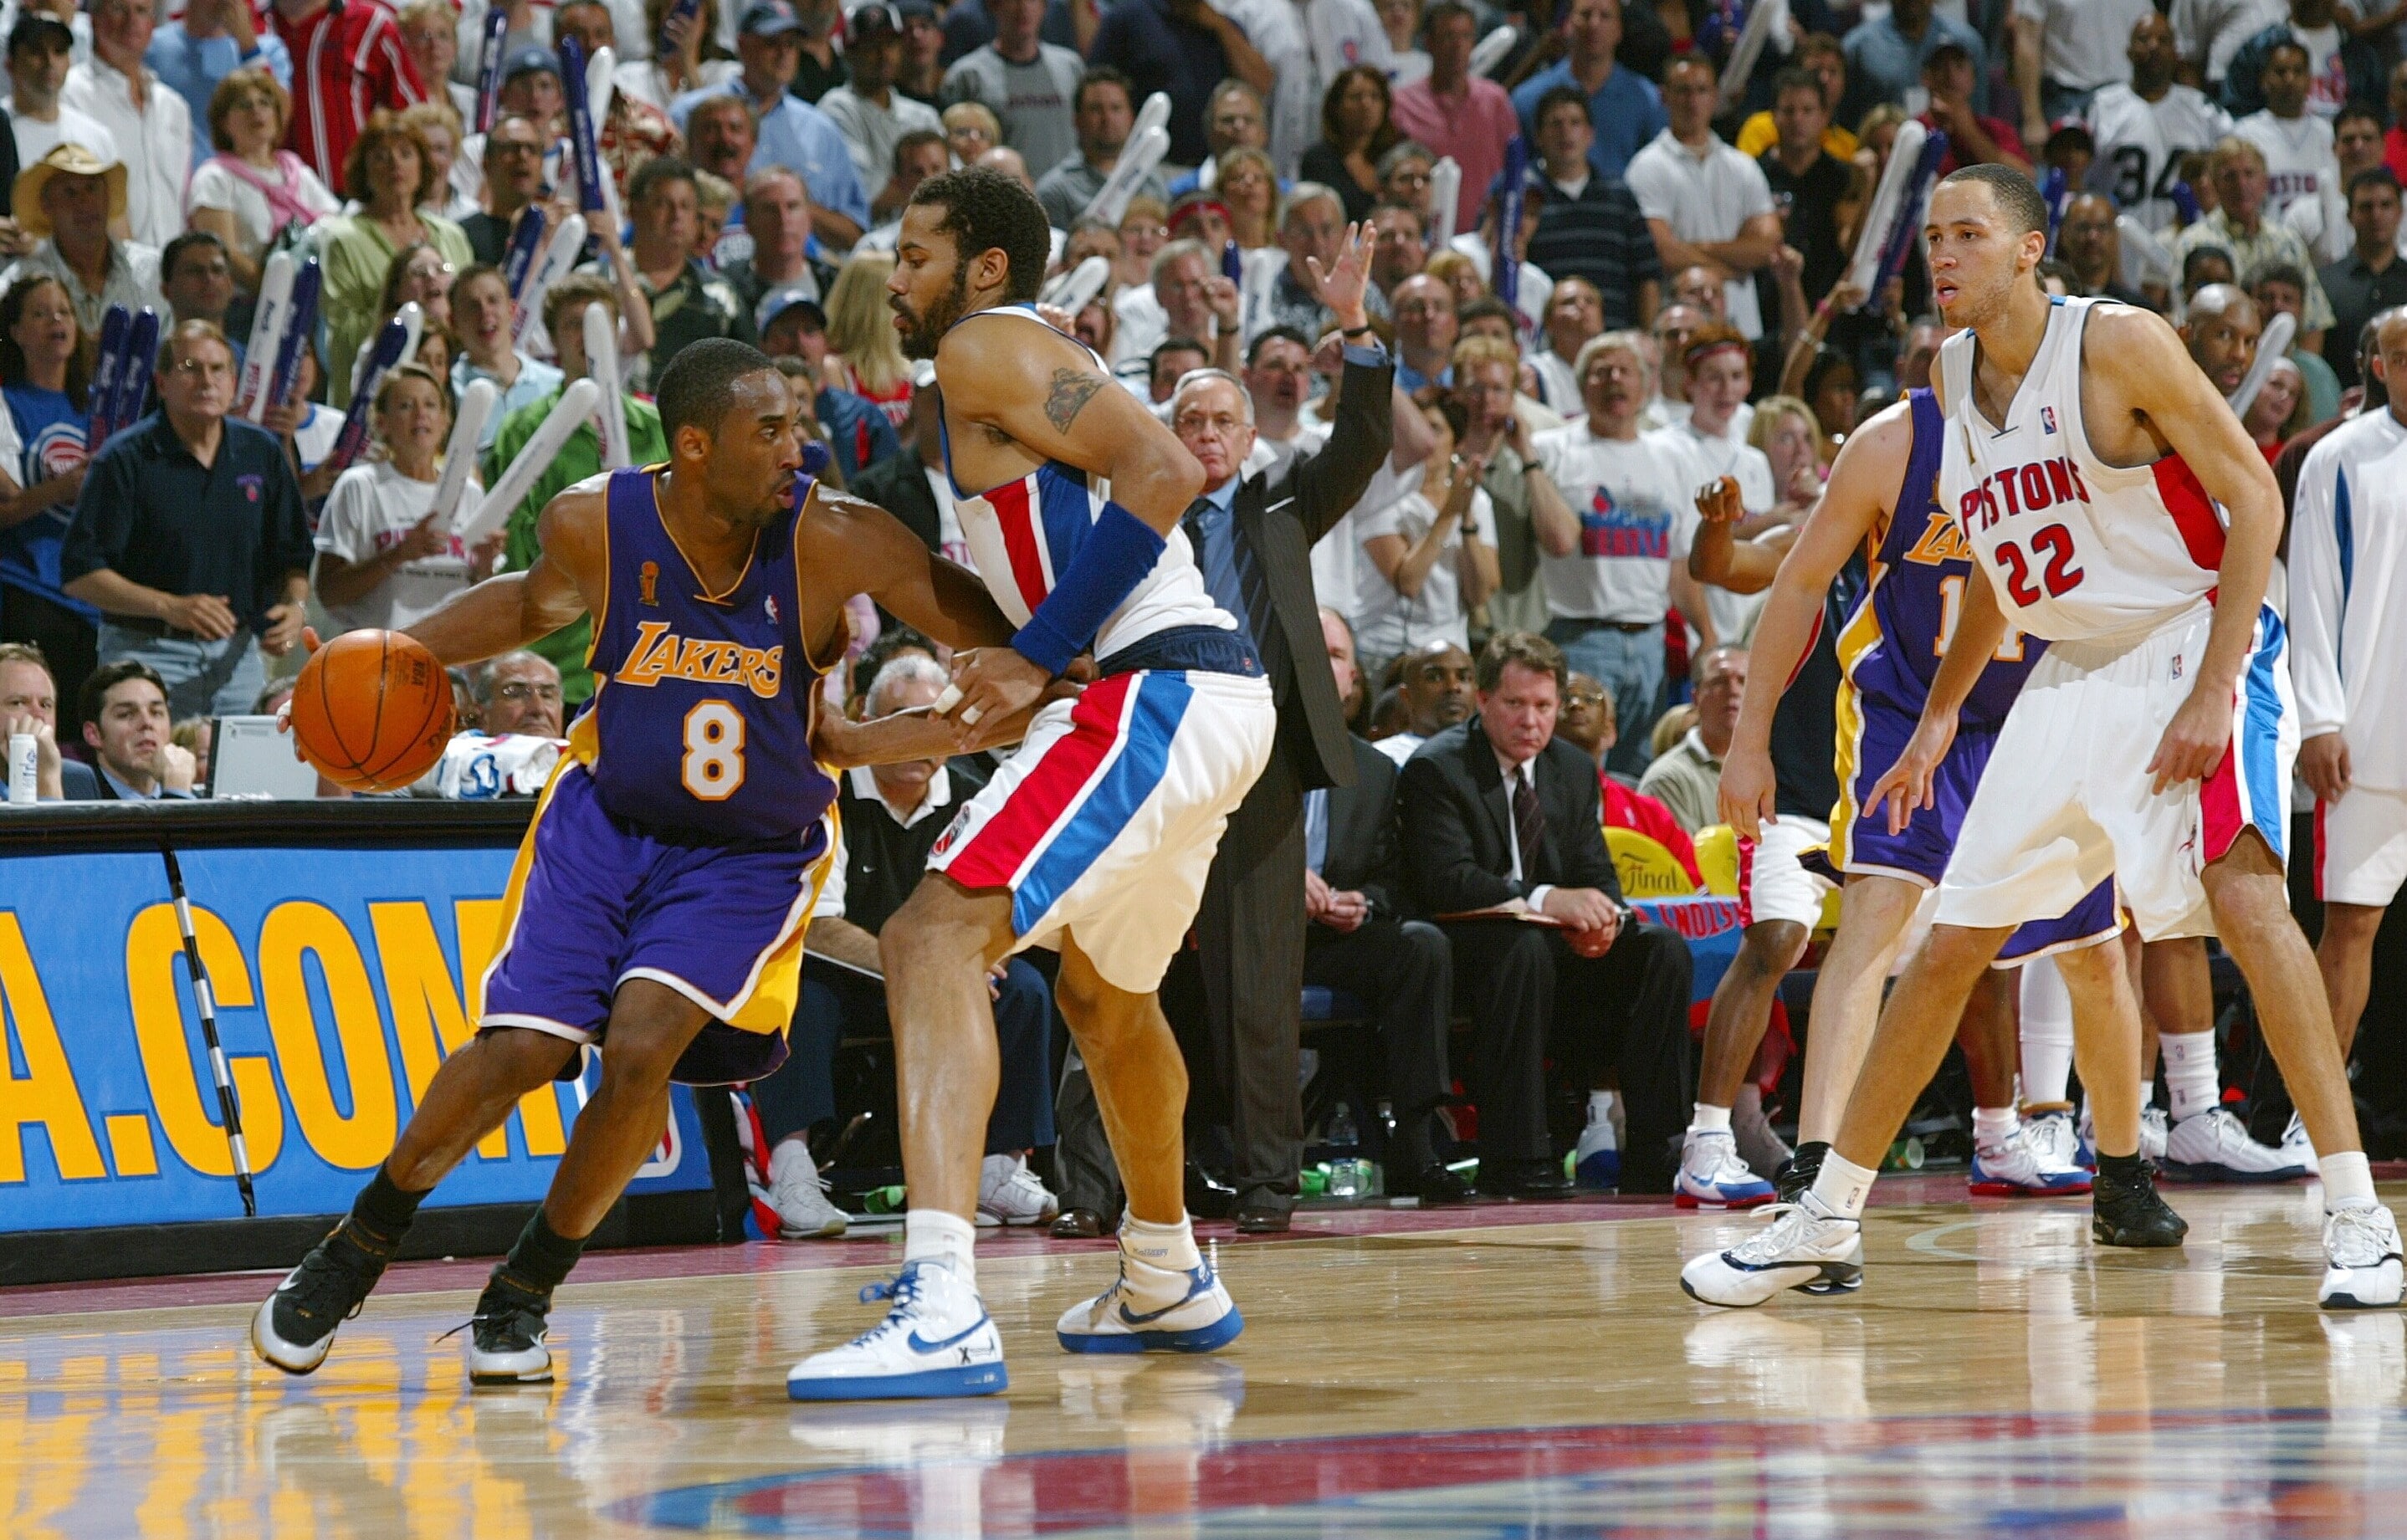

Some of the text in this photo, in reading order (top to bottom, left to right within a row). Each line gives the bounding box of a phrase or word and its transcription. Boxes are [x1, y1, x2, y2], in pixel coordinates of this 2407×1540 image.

[1959, 456, 2091, 542] PISTONS
[1995, 523, 2086, 609] 22
[613, 621, 784, 699] LAKERS
[681, 698, 748, 802] 8
